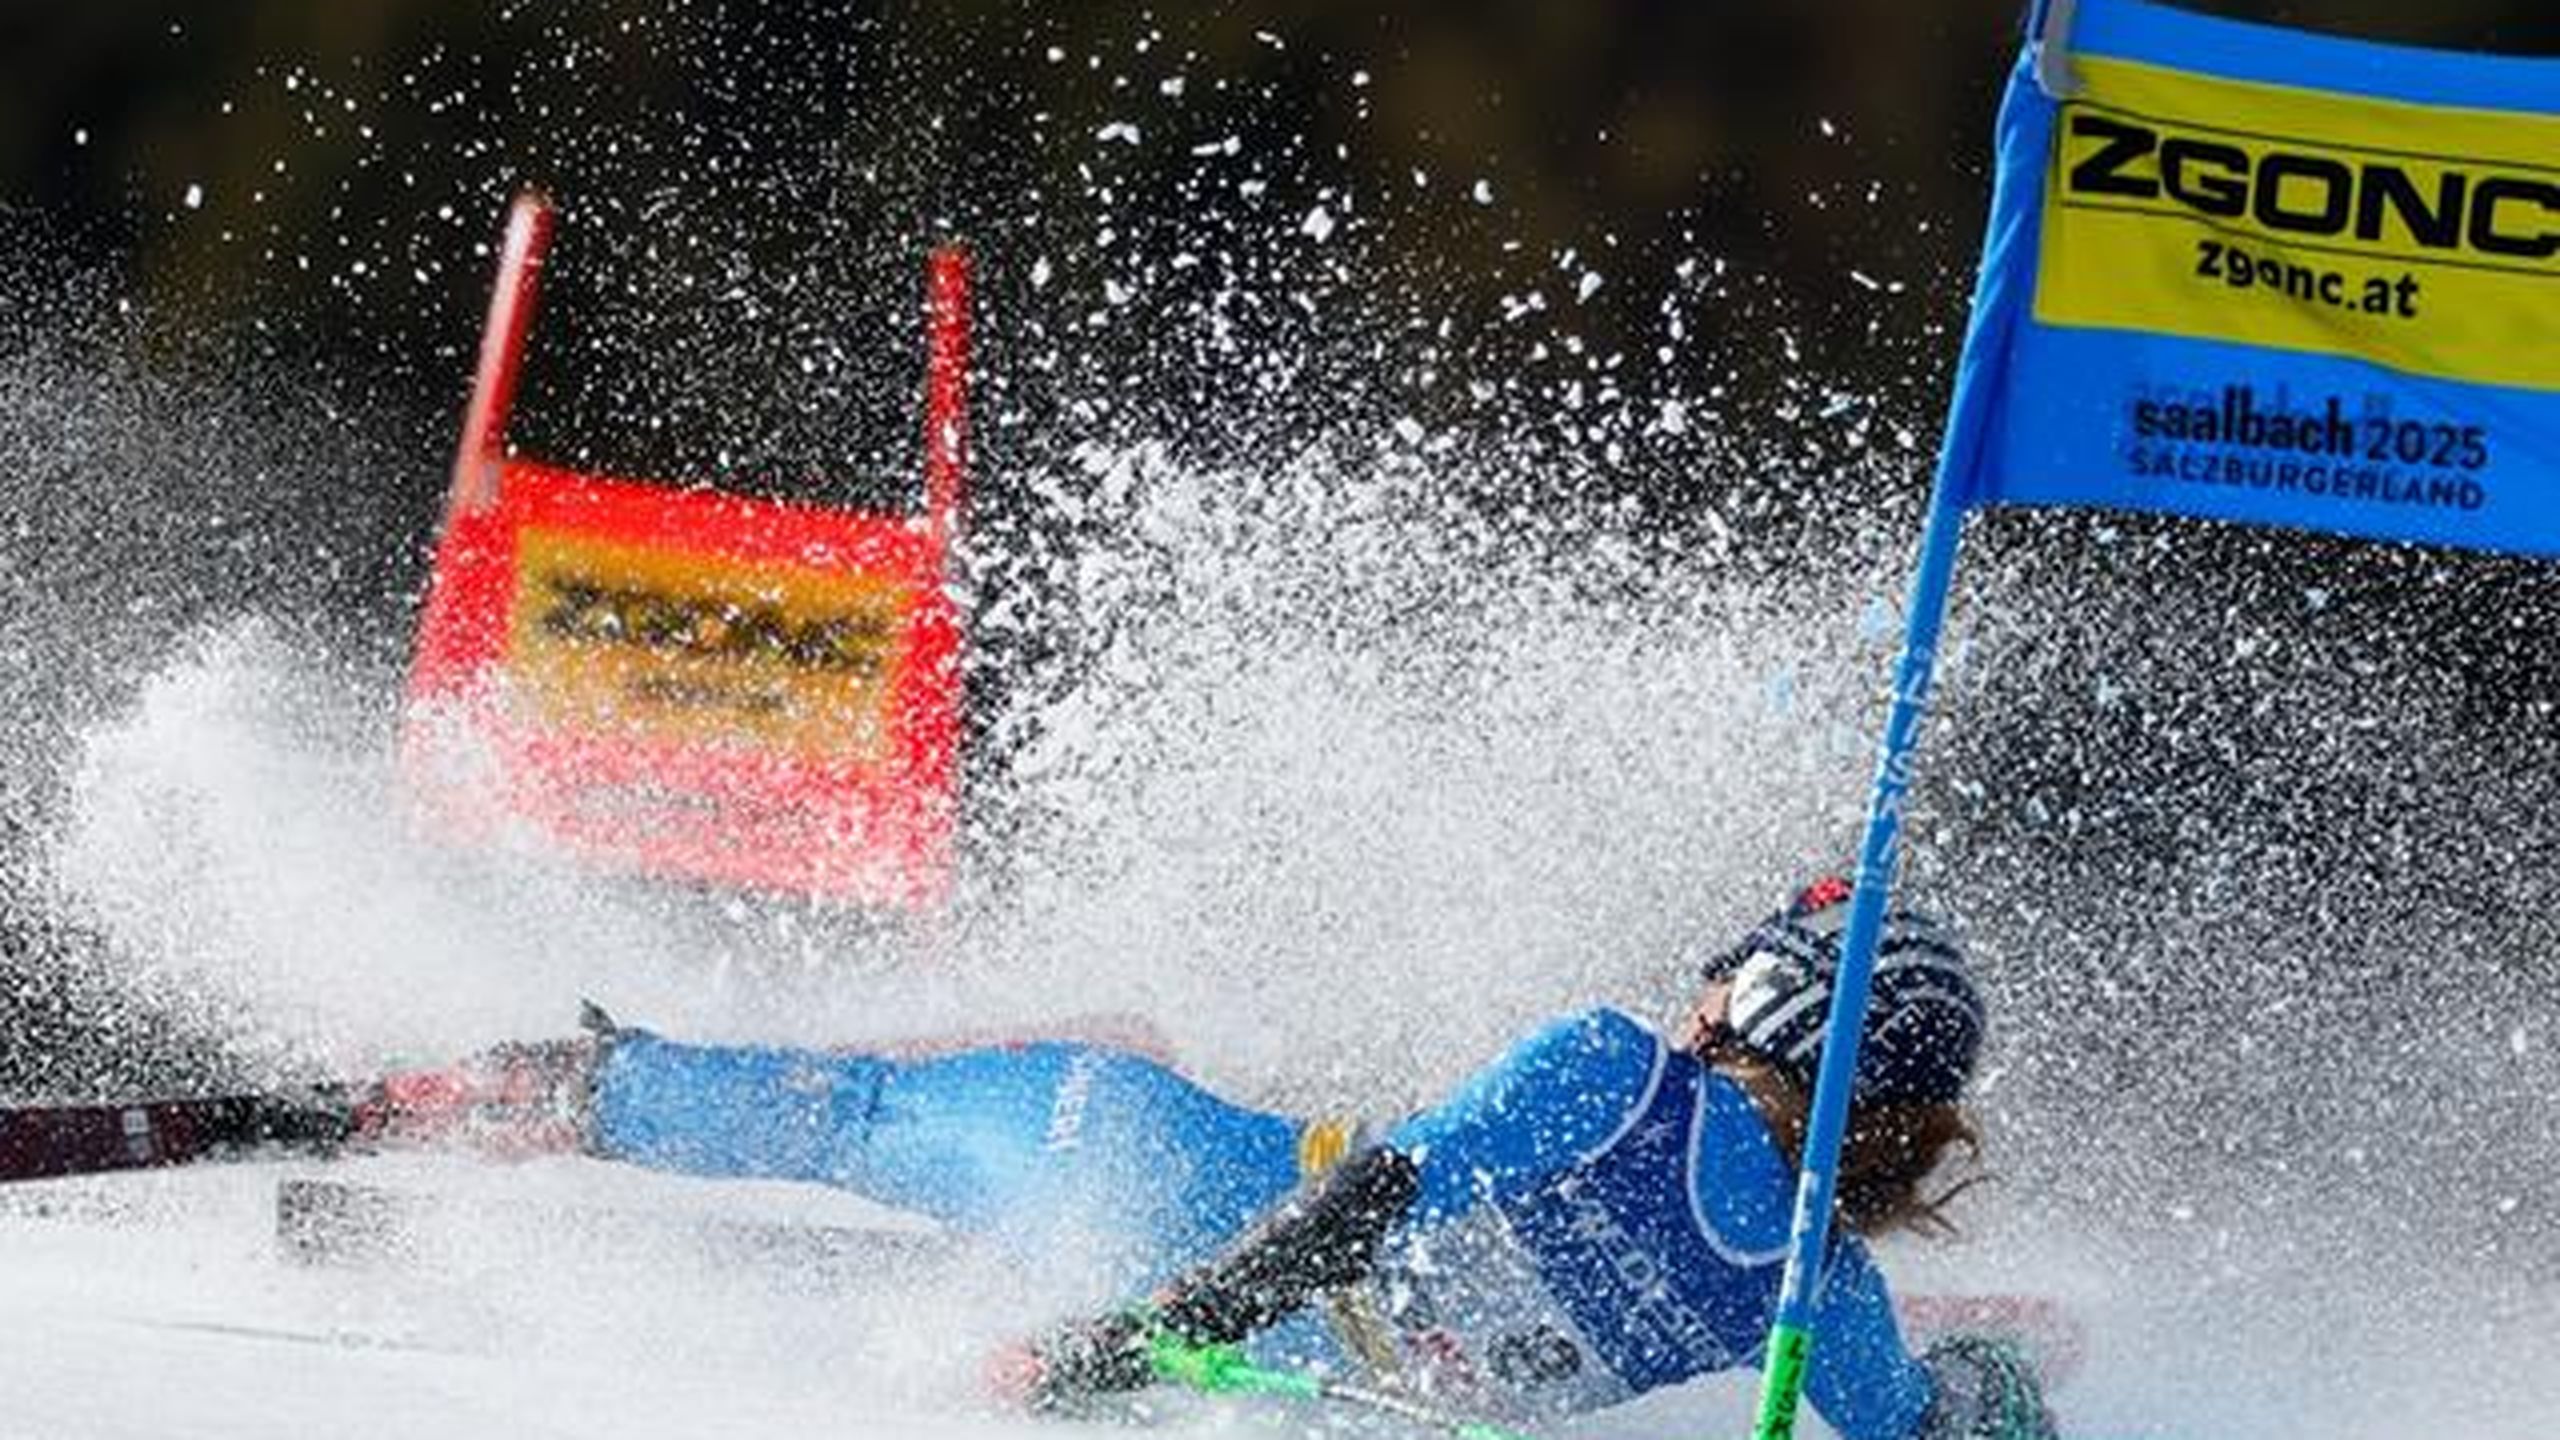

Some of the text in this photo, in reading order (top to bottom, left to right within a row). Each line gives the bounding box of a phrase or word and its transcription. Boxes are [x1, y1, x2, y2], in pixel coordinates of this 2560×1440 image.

[2071, 115, 2560, 257] ZGONC
[2197, 240, 2419, 317] zgonc.at
[2134, 385, 2488, 470] saalbach 2025
[2129, 449, 2485, 511] SALZBURGERLAND
